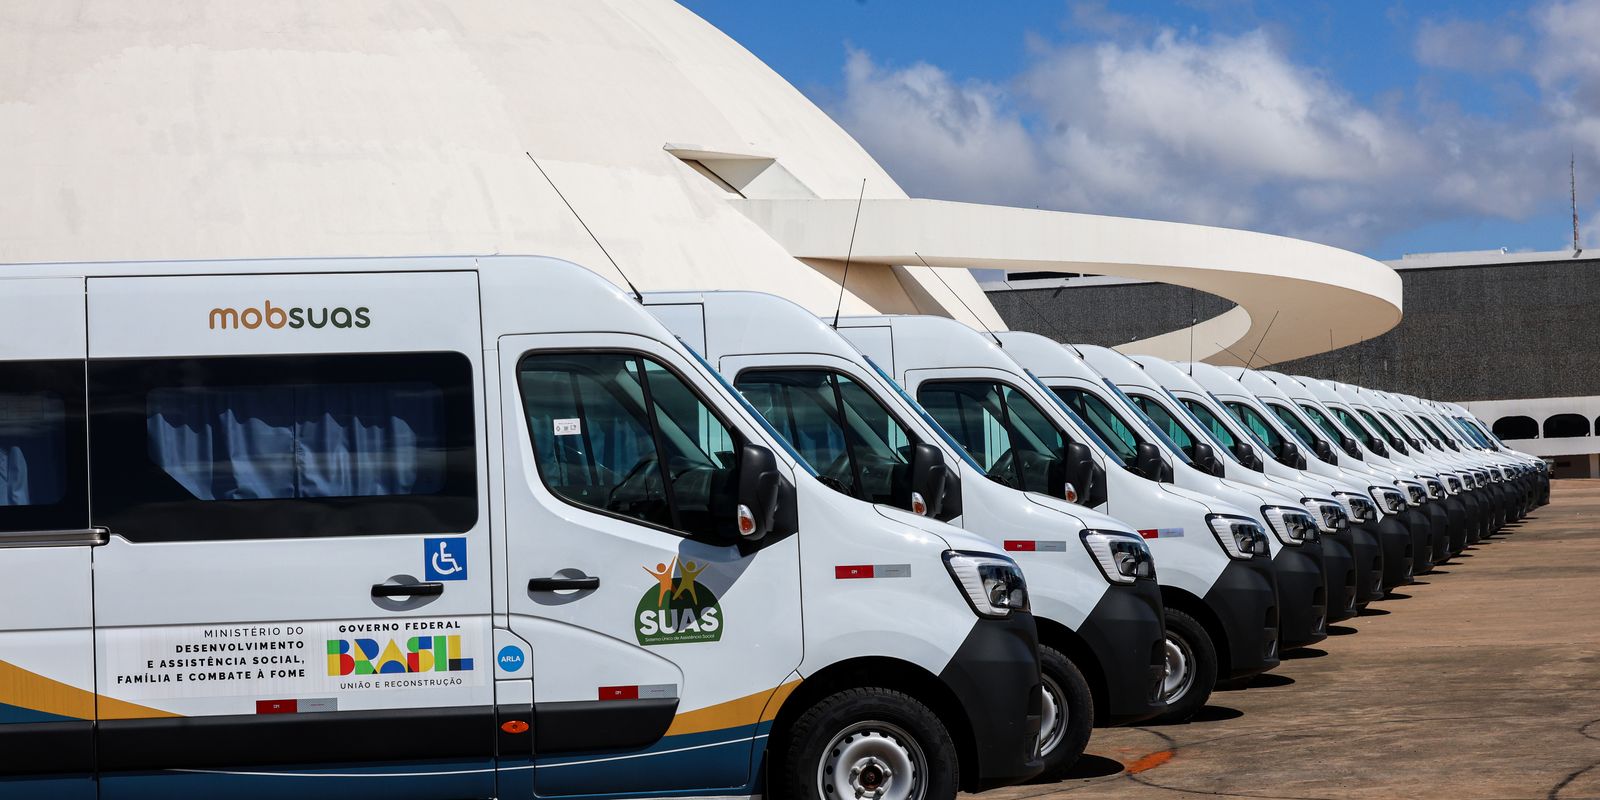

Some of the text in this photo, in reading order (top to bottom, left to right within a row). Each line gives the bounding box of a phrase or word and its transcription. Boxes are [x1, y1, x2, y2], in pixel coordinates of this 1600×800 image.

[209, 300, 371, 330] mobsuas
[640, 606, 719, 635] SUAS
[204, 626, 304, 638] MINISTÉRIO DO
[339, 621, 461, 633] GOVERNO FEDERAL
[175, 641, 304, 653] DESENVOLVIMENTO
[147, 655, 305, 668] E ASSISTÊNCIA SOCIAL,
[327, 635, 474, 676] BRASIL
[501, 655, 521, 663] ARLA
[117, 668, 305, 684] FAMÍLIA E COMBATE À FOME
[340, 680, 371, 689] UNIÃO
[384, 677, 462, 688] RECONSTRUÇÃO
